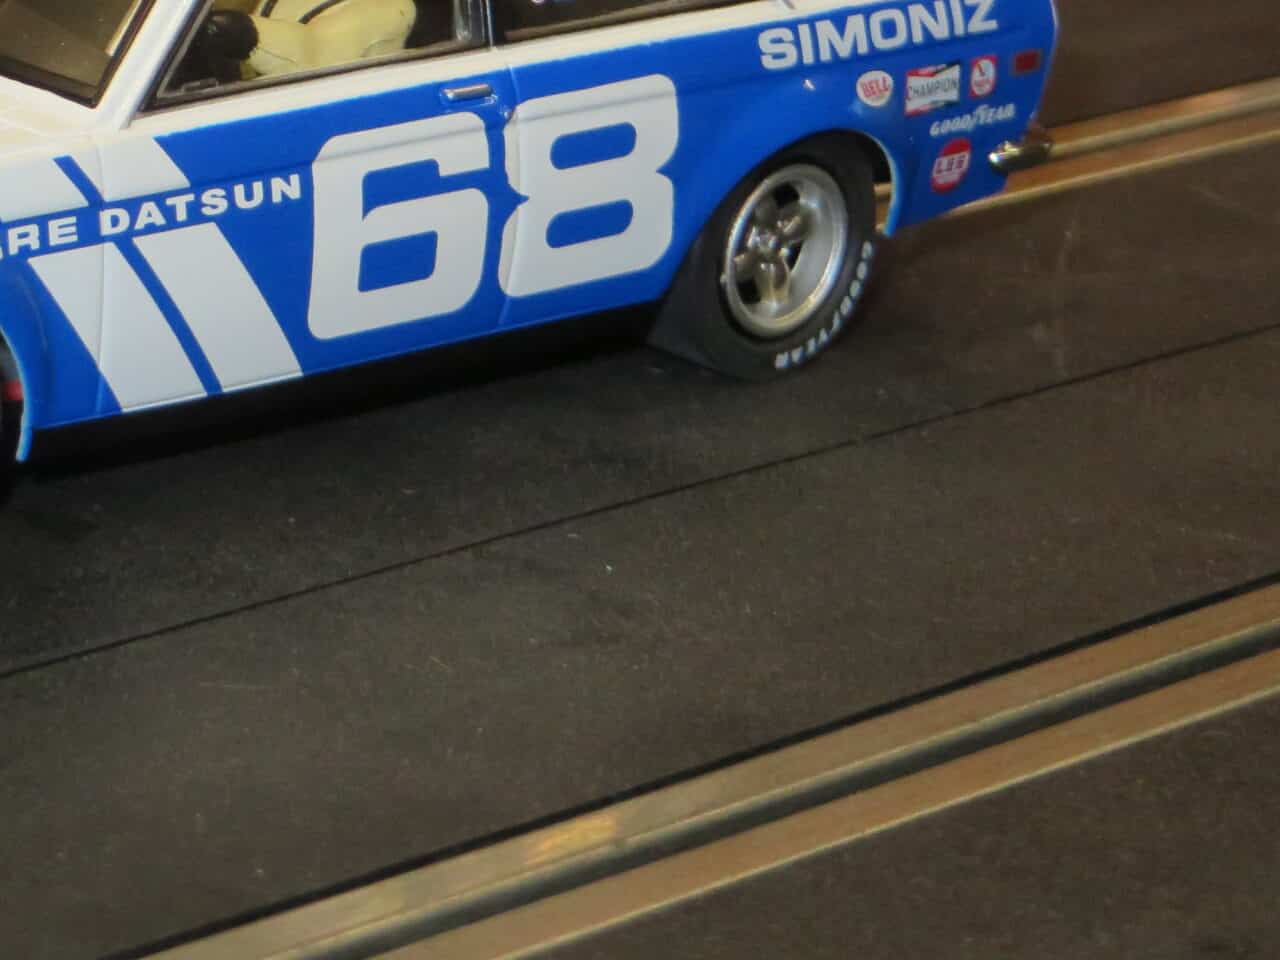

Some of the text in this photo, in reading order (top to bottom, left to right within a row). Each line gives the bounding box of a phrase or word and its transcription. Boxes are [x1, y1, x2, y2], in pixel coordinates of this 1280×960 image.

[859, 76, 890, 99] BELL
[907, 77, 960, 101] CHAMPION
[99, 173, 301, 236] DATSUN
[307, 73, 679, 341] 68
